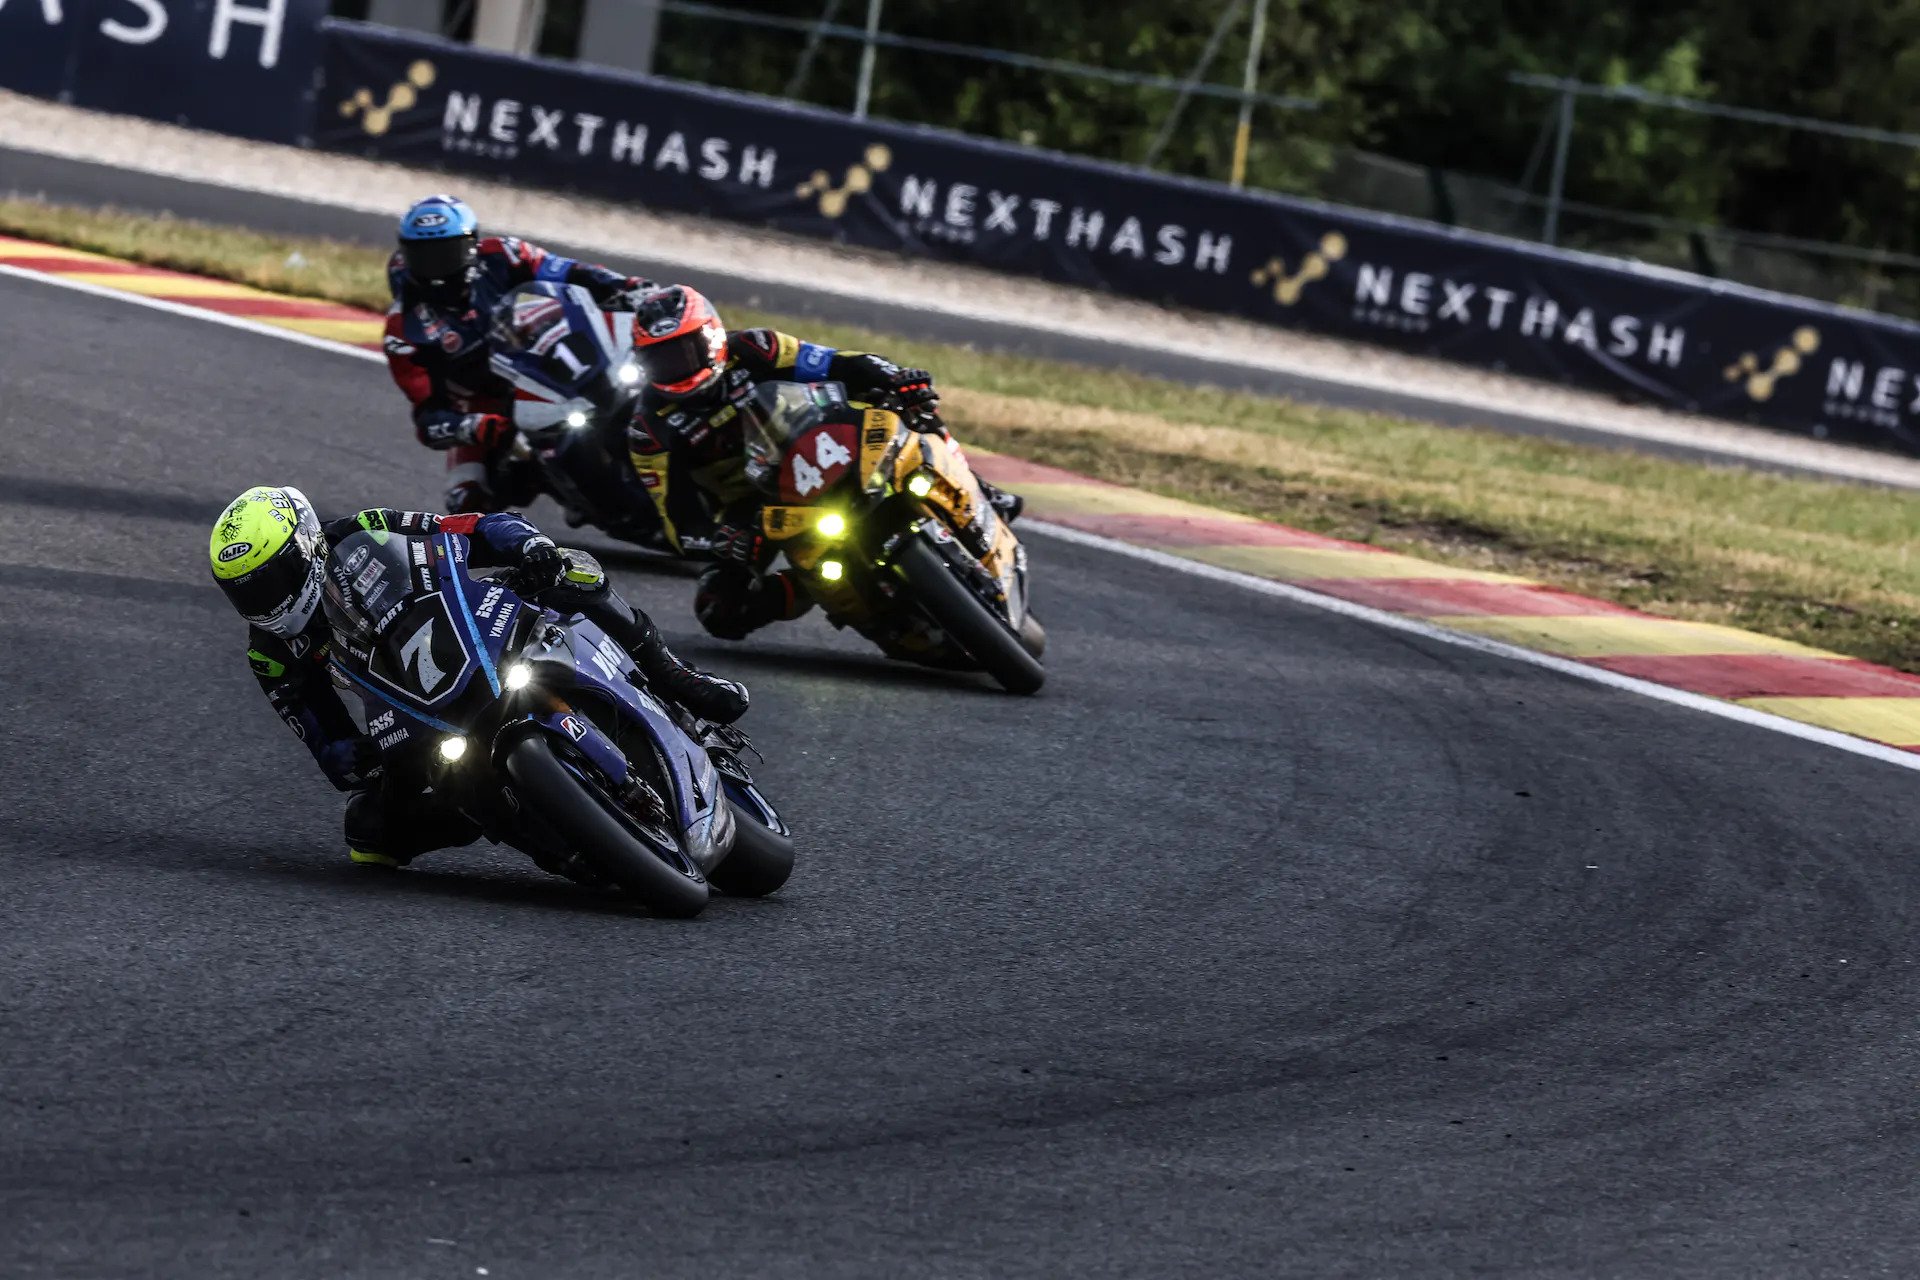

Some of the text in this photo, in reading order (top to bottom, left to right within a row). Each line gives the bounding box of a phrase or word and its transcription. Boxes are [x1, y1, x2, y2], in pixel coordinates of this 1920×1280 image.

[443, 91, 777, 188] NEXTHASH
[899, 175, 1233, 273] NEXTHASH
[1355, 263, 1686, 368] NEXTHASH
[552, 341, 592, 380] 1
[792, 431, 852, 496] 44
[221, 545, 250, 561] HJC
[333, 565, 353, 609] YAMAHA
[420, 567, 433, 592] GYTR
[374, 600, 404, 635] YART
[489, 603, 516, 638] YAMAHA
[400, 617, 447, 694] 7
[378, 727, 410, 751] YAMAHA
